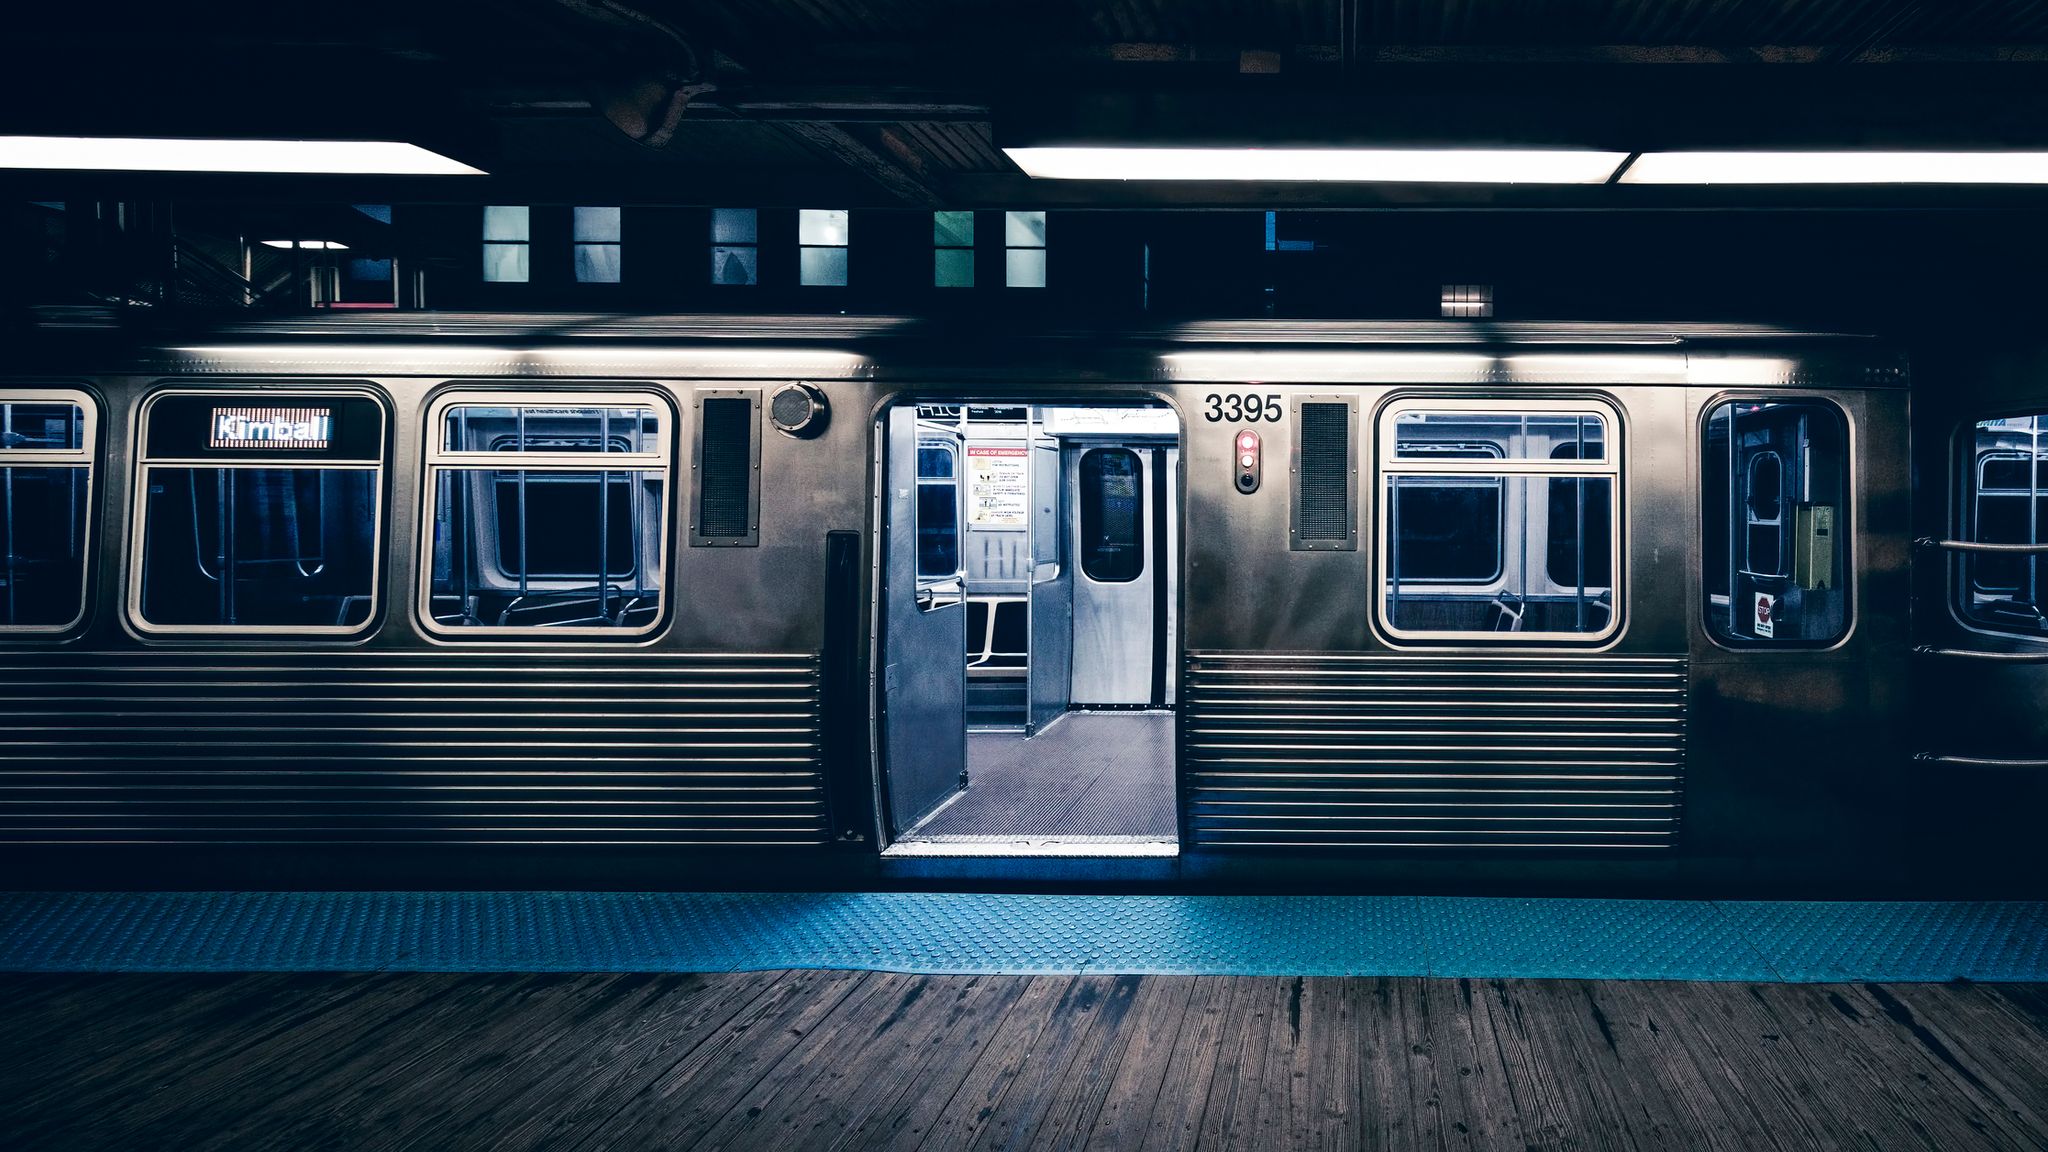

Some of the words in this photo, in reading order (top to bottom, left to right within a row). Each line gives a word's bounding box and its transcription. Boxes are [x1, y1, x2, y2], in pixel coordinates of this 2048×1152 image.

[1204, 393, 1283, 423] 3395
[218, 415, 328, 440] Kimball
[1758, 605, 1770, 615] STOP
